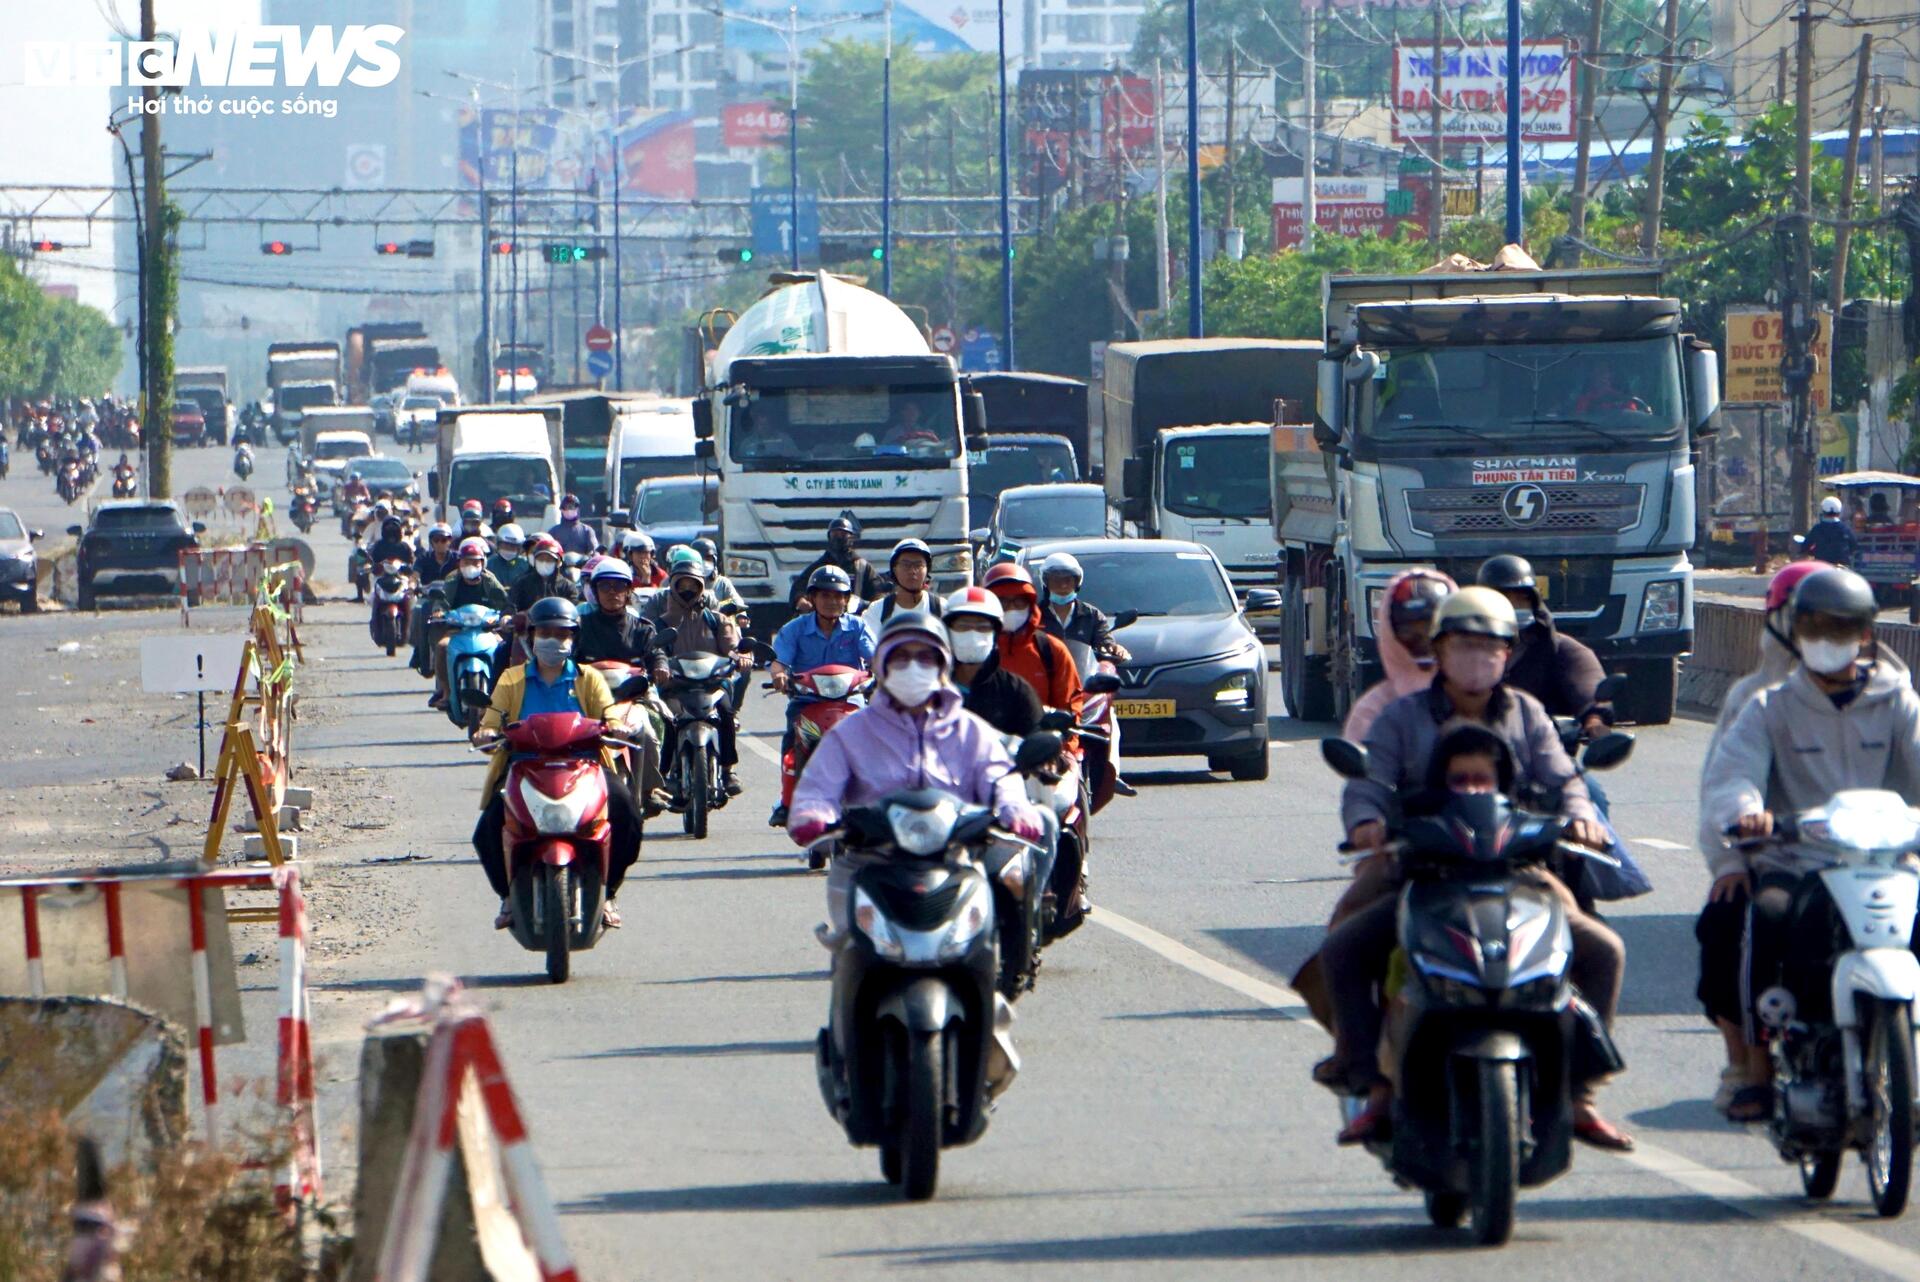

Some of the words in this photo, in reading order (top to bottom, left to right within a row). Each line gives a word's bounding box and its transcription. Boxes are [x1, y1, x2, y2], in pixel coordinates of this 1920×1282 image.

[1472, 457, 1577, 469] SHACMAN
[1474, 471, 1517, 484] PHỤNG
[1520, 469, 1544, 482] TÂN
[1548, 469, 1576, 481] TIẾN
[838, 477, 859, 489] TÔNG
[861, 478, 883, 489] XANH
[1116, 703, 1168, 715] H-075.31
